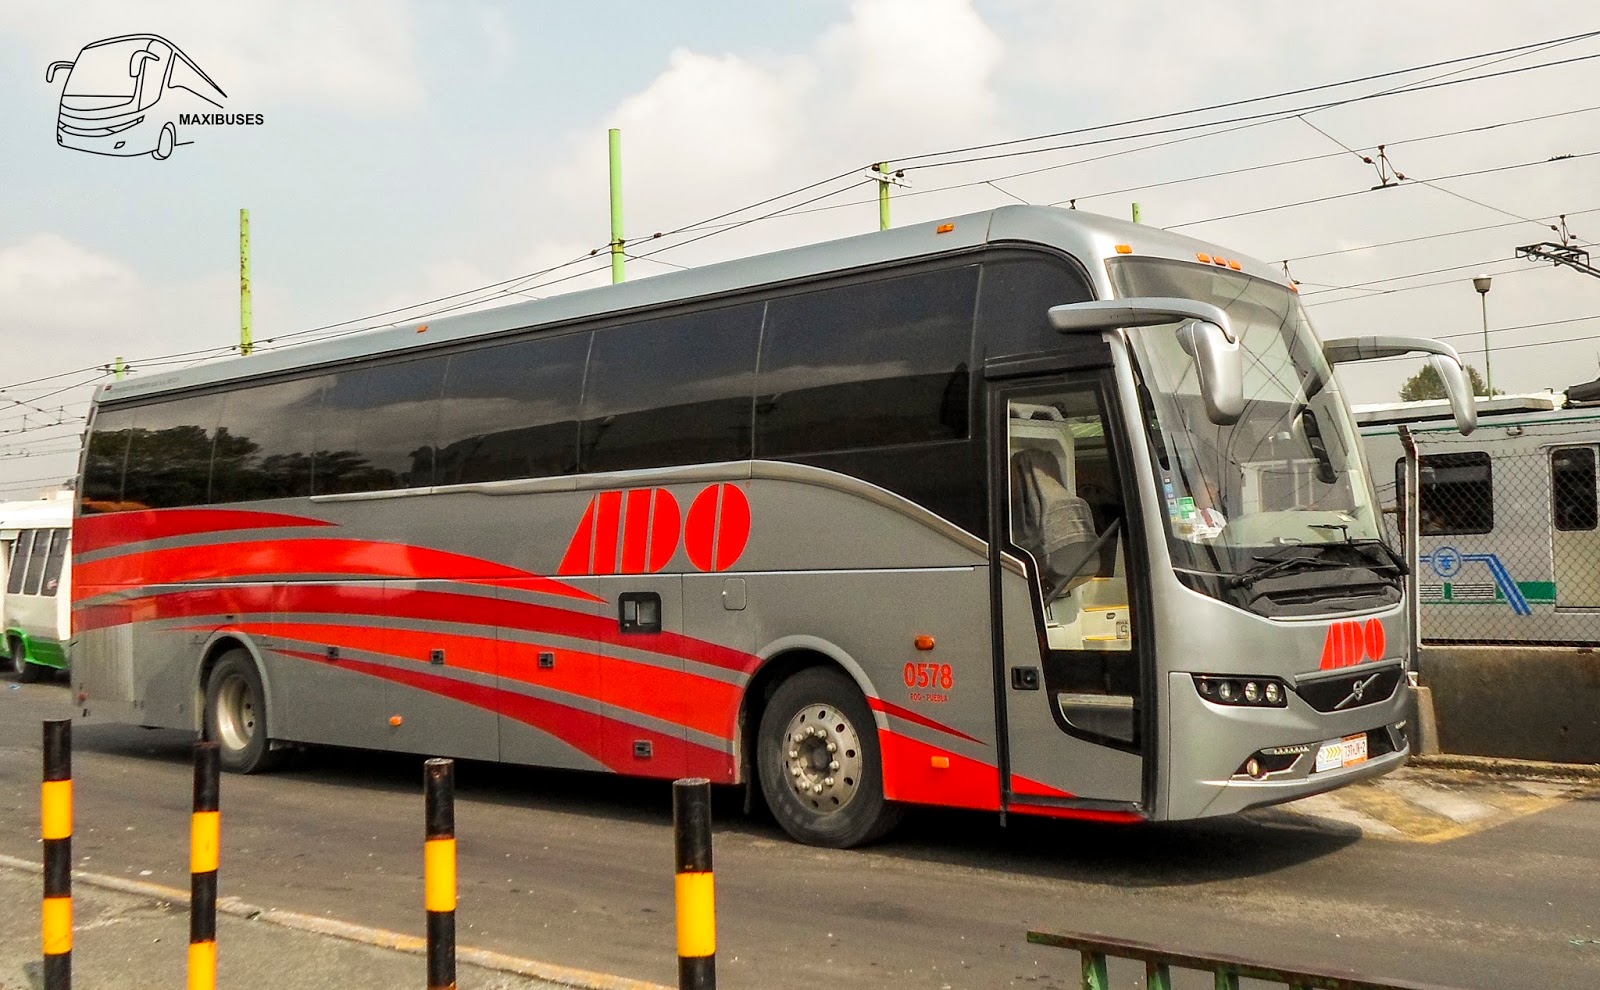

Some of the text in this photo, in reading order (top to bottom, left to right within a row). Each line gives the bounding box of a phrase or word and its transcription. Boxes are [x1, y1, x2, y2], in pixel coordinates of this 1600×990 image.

[556, 482, 752, 575] ADO
[1319, 617, 1386, 671] ADO
[903, 662, 953, 689] 0578
